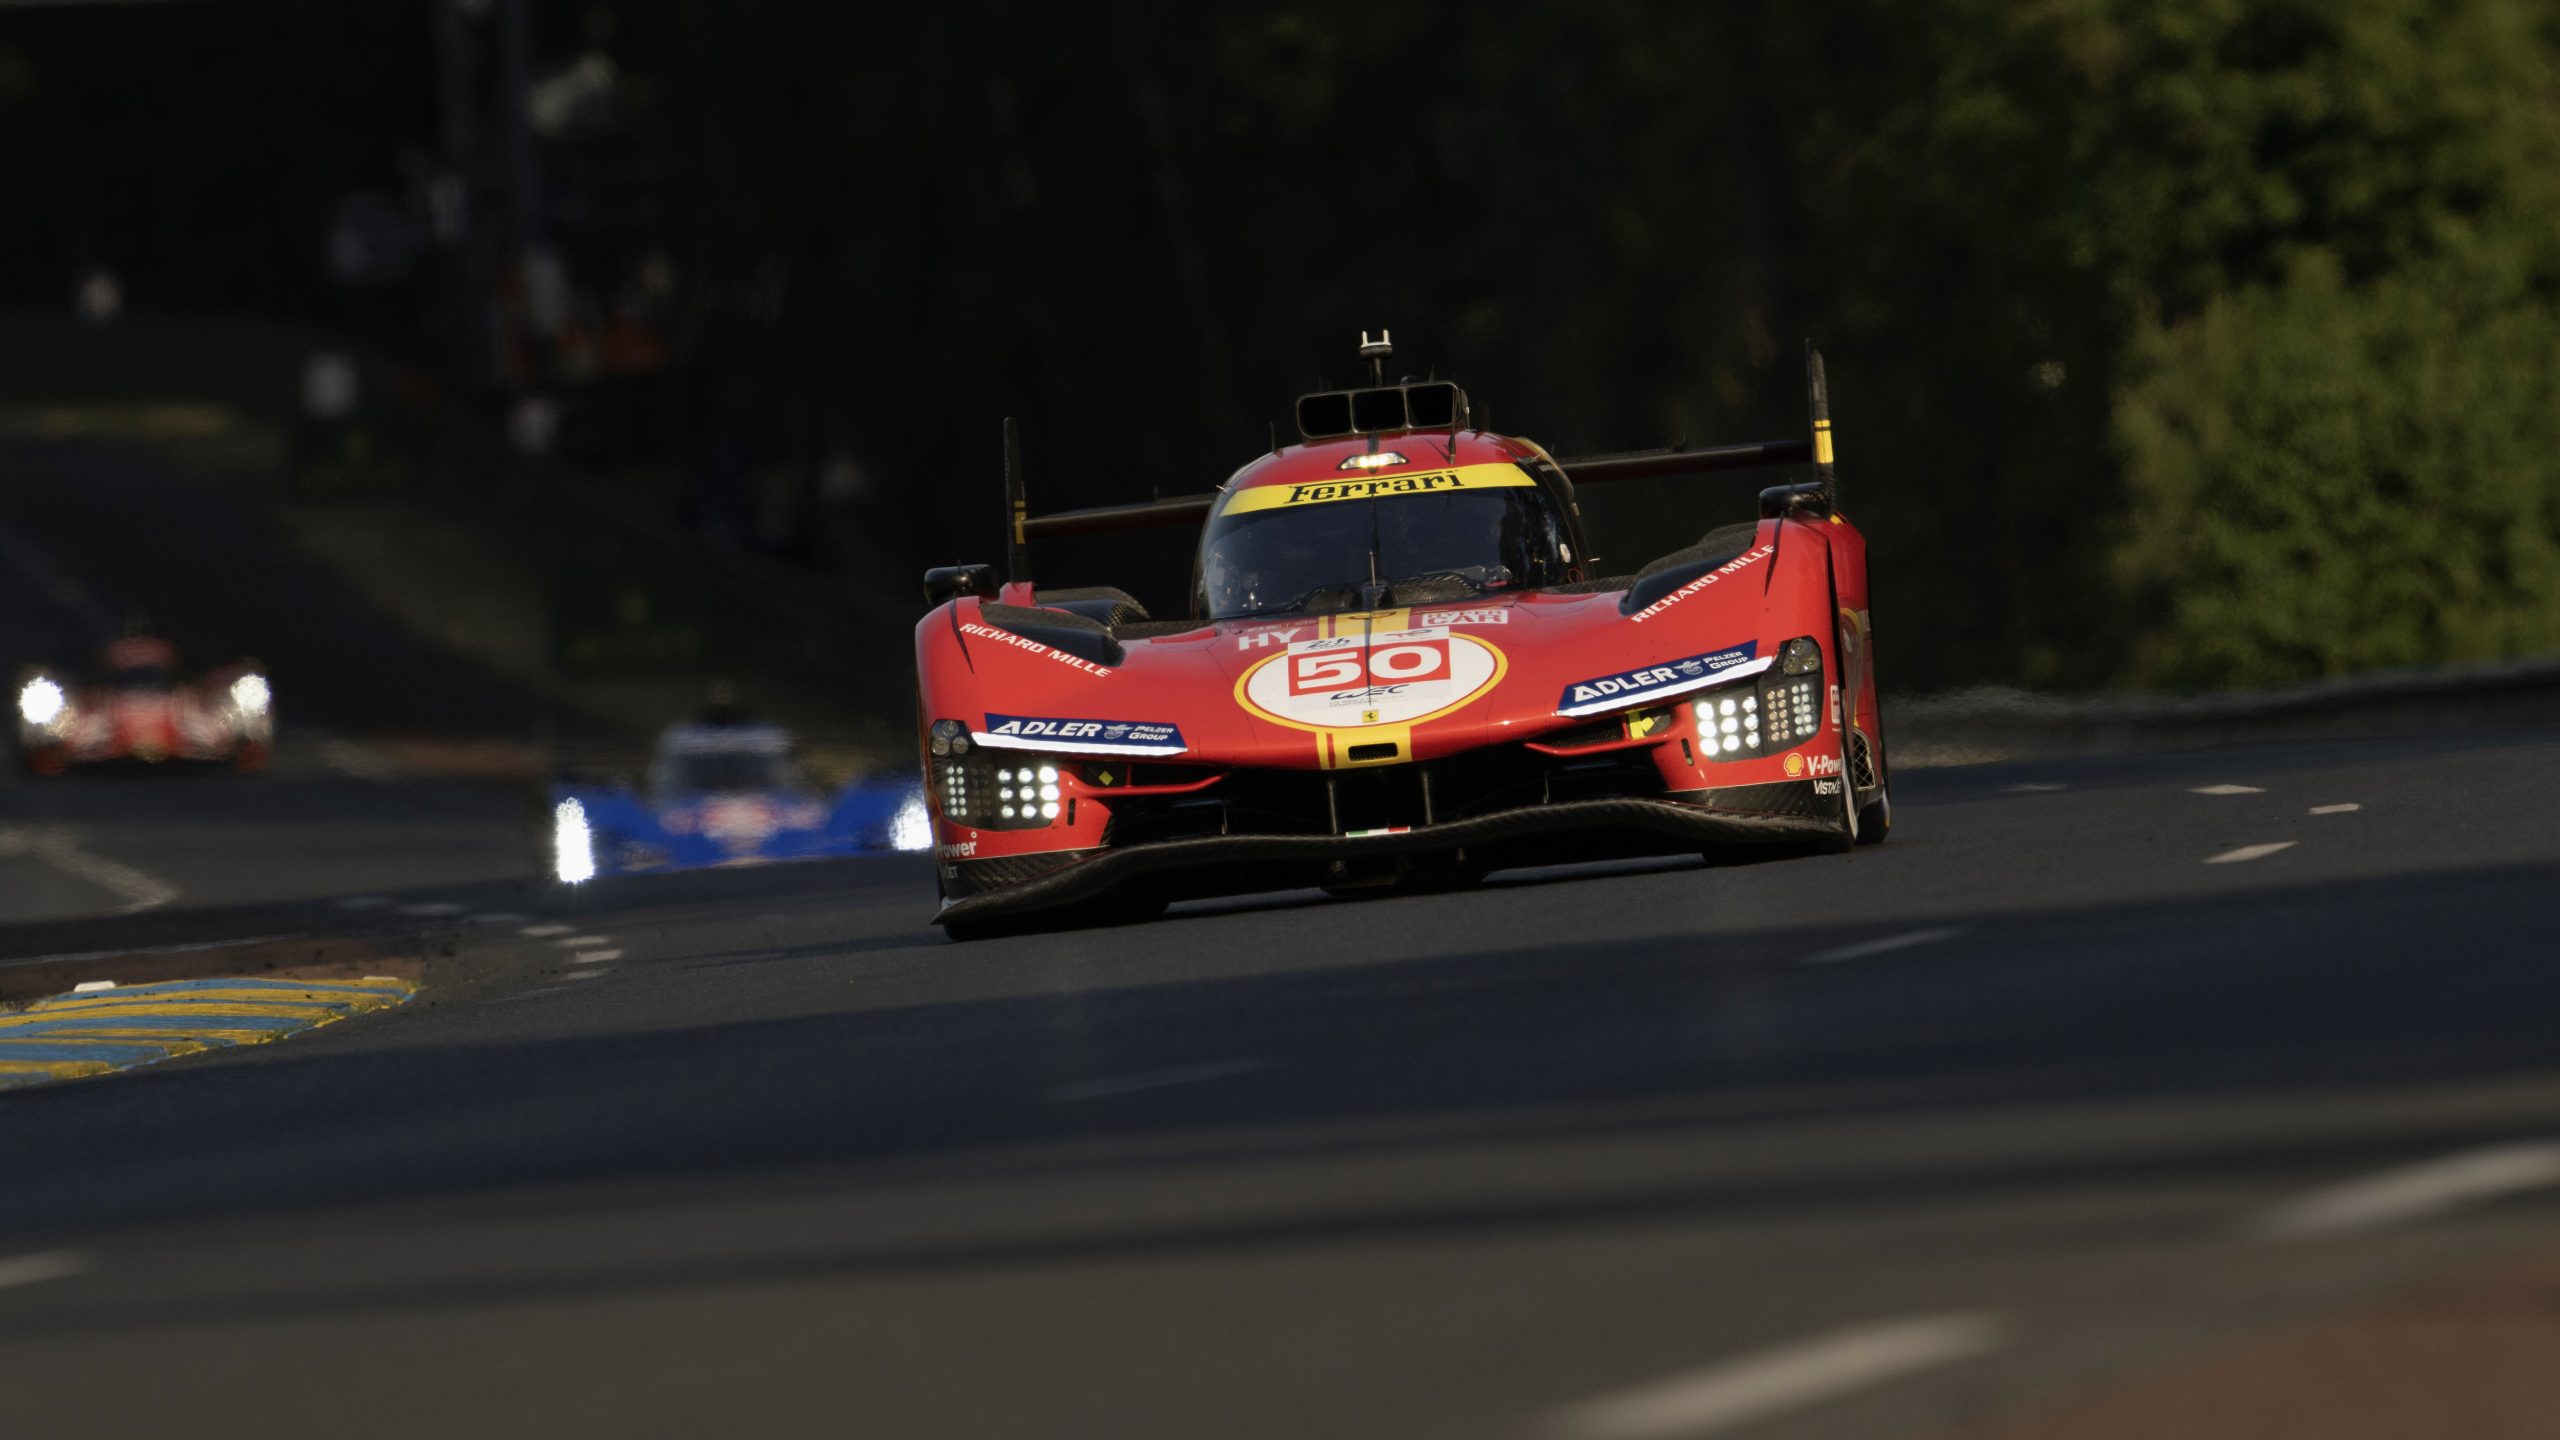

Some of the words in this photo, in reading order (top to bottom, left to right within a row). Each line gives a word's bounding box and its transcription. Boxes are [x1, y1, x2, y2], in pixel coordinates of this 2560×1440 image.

[1284, 470, 1465, 504] Ferrari
[1631, 573, 1719, 624] RICHARD
[1719, 544, 1776, 576] MILLE
[1427, 613, 1503, 625] CAR
[959, 623, 1045, 653] RICHARD
[1047, 649, 1113, 678] MILLE
[1297, 645, 1443, 690] 50
[1329, 683, 1411, 701] WEC
[1574, 667, 1679, 702] ADLER
[991, 720, 1103, 738] ADLER
